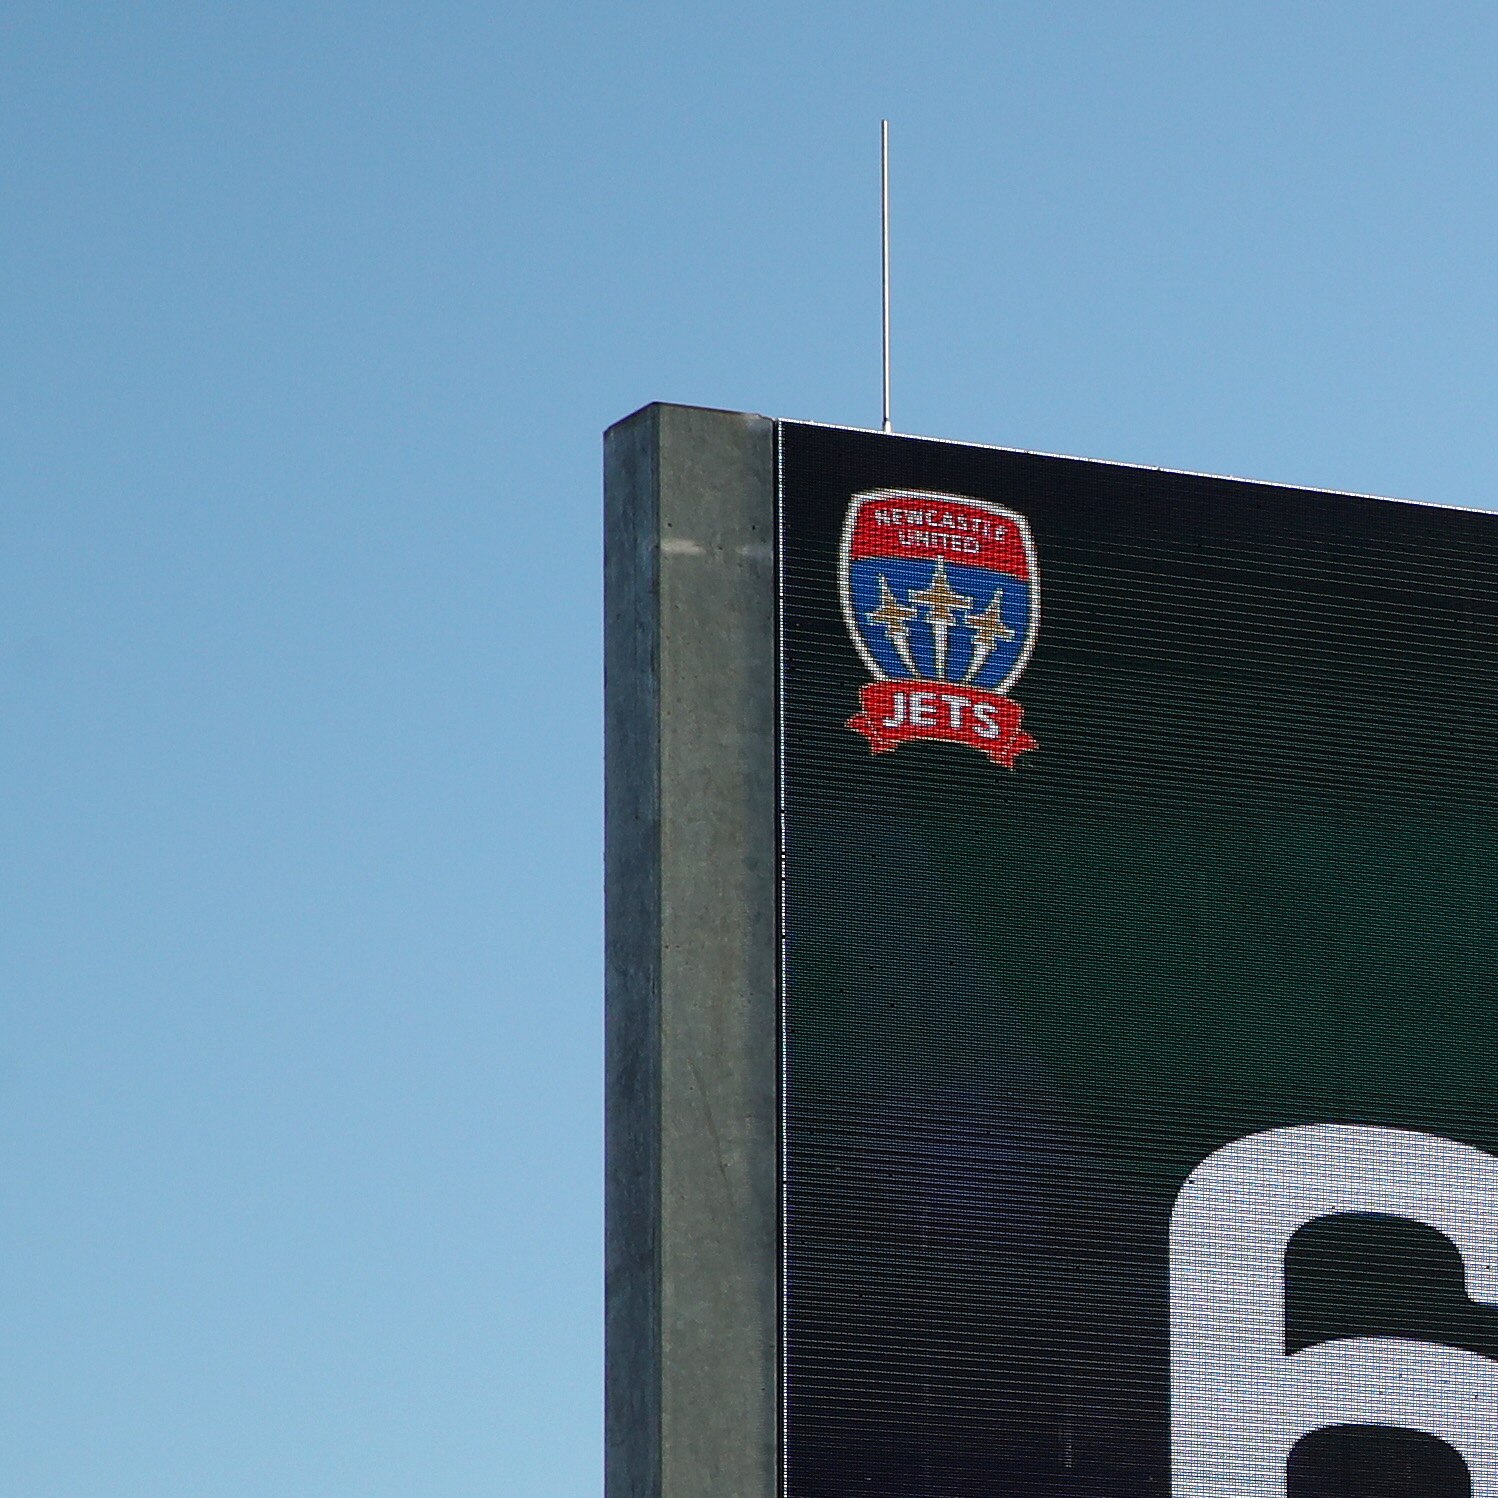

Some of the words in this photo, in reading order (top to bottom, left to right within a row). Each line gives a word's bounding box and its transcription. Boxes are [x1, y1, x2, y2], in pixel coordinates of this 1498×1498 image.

[874, 508, 1007, 541] NEWCASTLE
[898, 529, 980, 553] UNITED
[882, 691, 1001, 740] JETS
